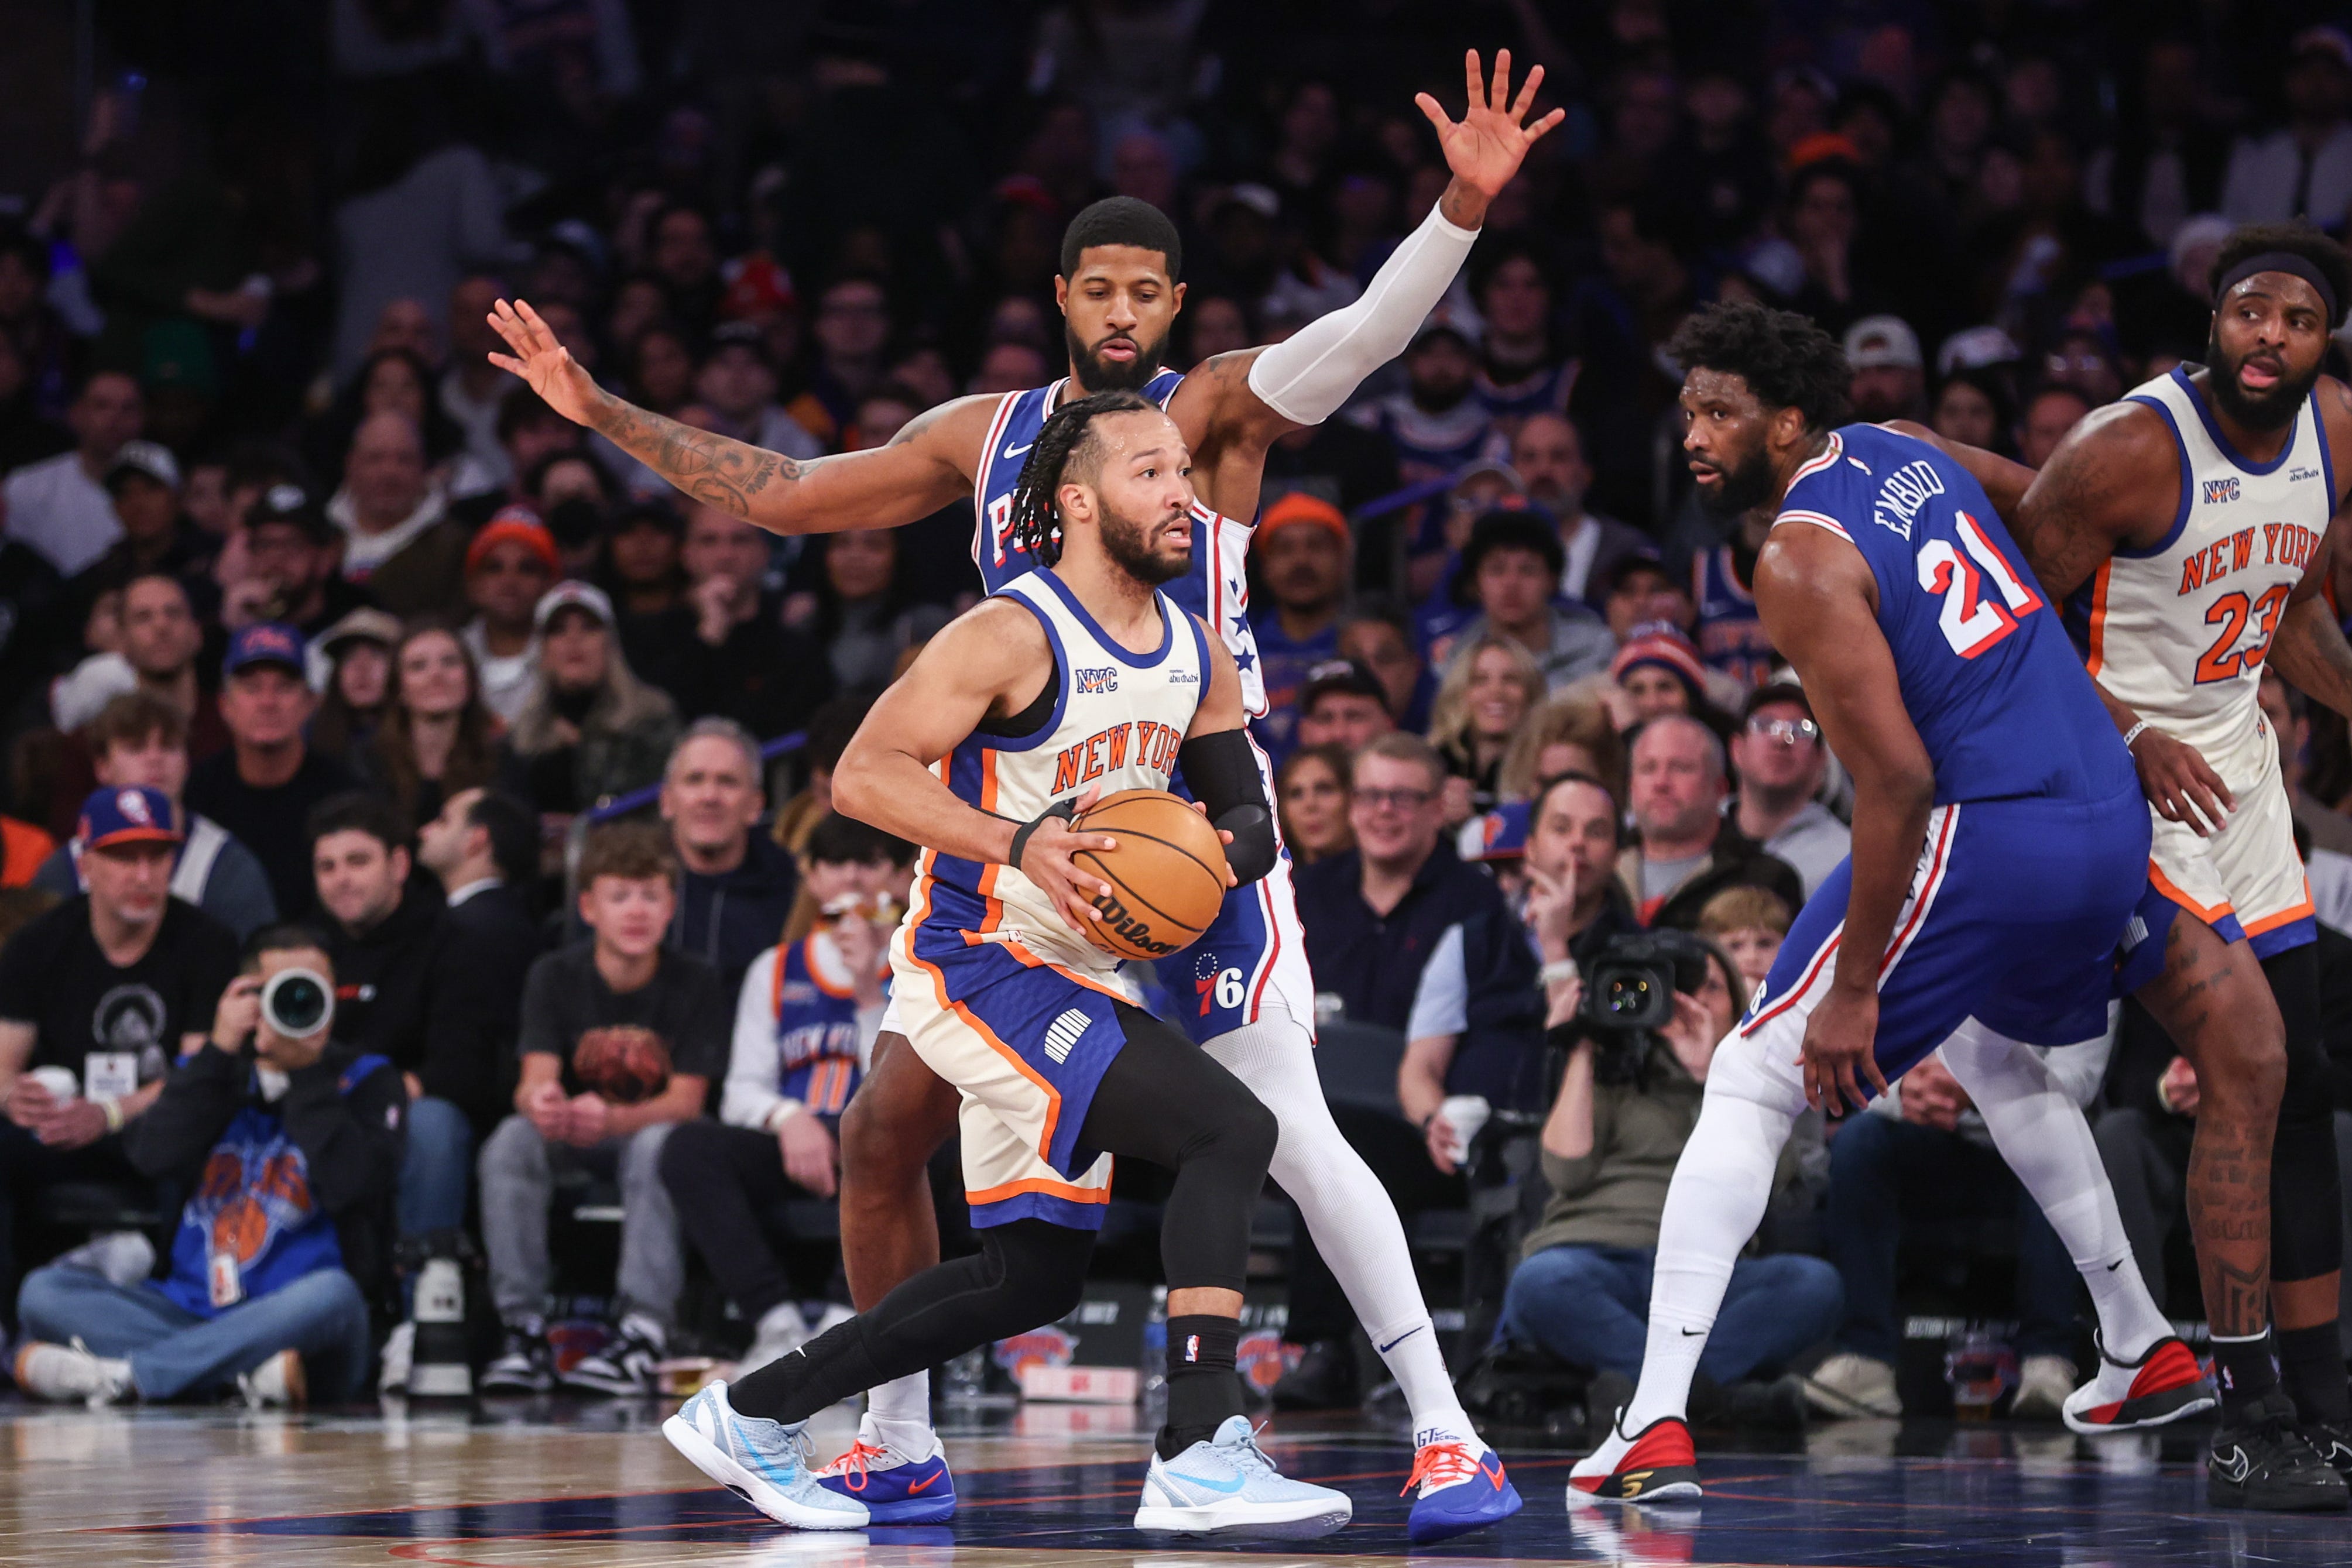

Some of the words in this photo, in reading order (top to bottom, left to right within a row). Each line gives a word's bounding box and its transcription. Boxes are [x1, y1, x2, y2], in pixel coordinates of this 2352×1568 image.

[1874, 460, 1945, 542] EMBIID
[2203, 478, 2240, 504] NYC
[1917, 509, 2044, 660] 21
[2177, 526, 2255, 596] NEW
[2193, 583, 2291, 686] 23
[1075, 667, 1118, 694] NYC
[1169, 674, 1180, 682] abu
[1181, 673, 1199, 682] dhabi
[1051, 721, 1132, 797] NEW
[1136, 720, 1181, 778] YOR
[1092, 894, 1181, 955] Wilson
[1195, 967, 1245, 1017] 76
